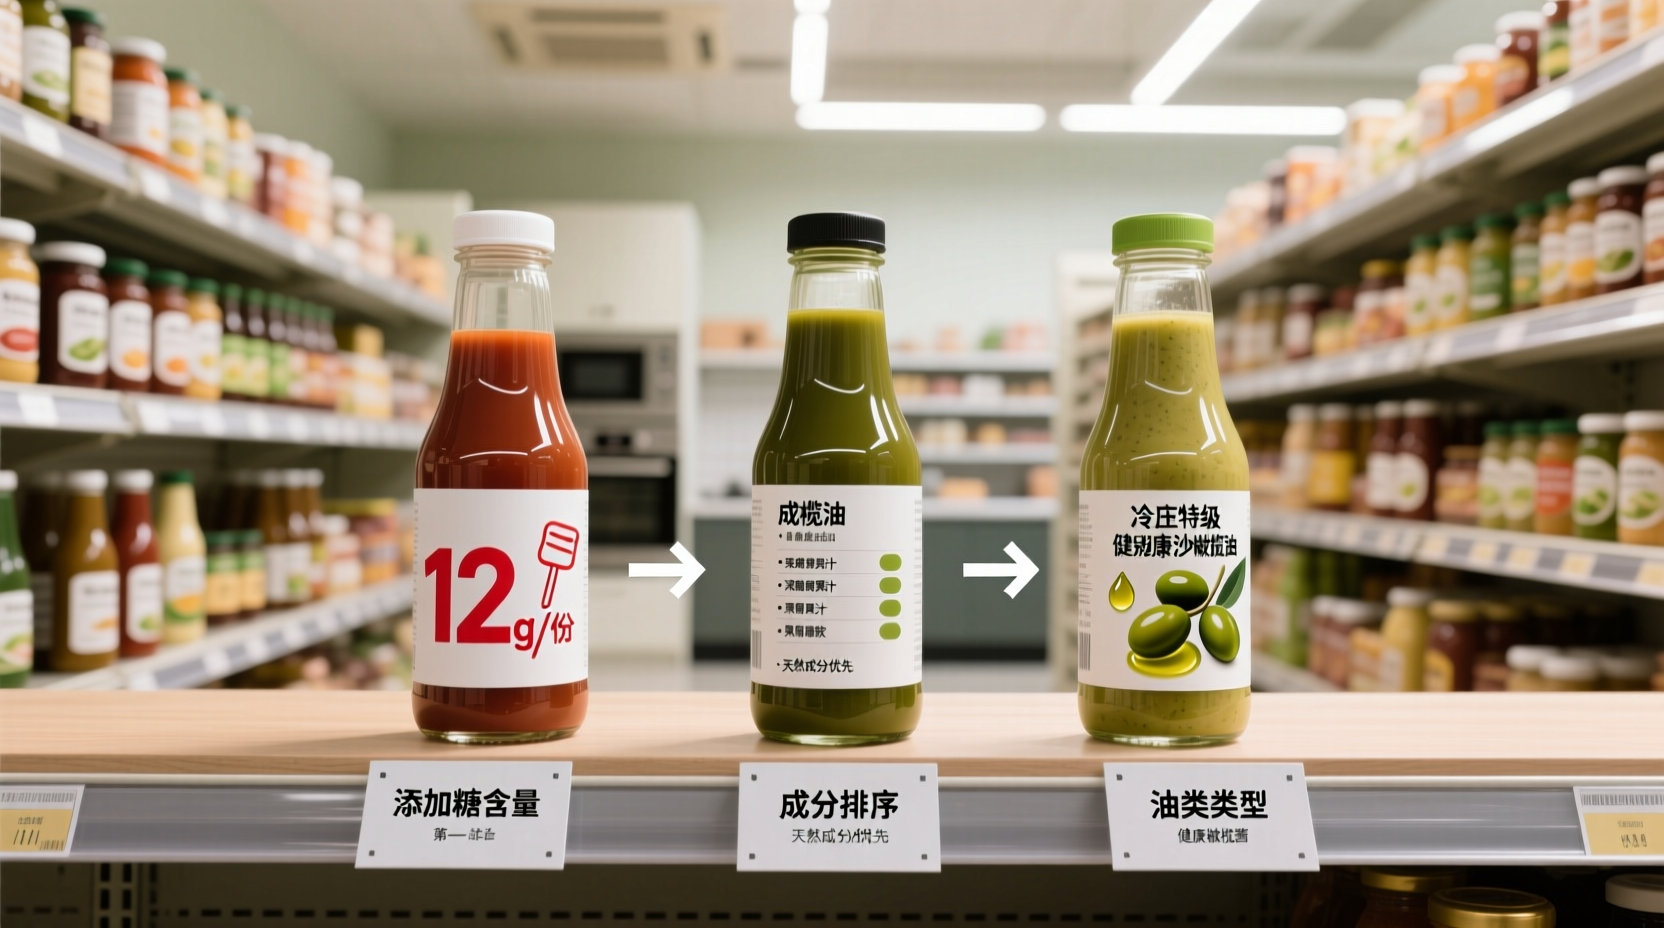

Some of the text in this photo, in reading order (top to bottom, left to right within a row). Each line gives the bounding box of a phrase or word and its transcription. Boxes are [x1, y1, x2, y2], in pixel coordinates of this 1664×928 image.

[393, 788, 541, 818] 添加糖含量
[779, 789, 899, 819] 成分排序
[1150, 789, 1268, 819] 油类类型
